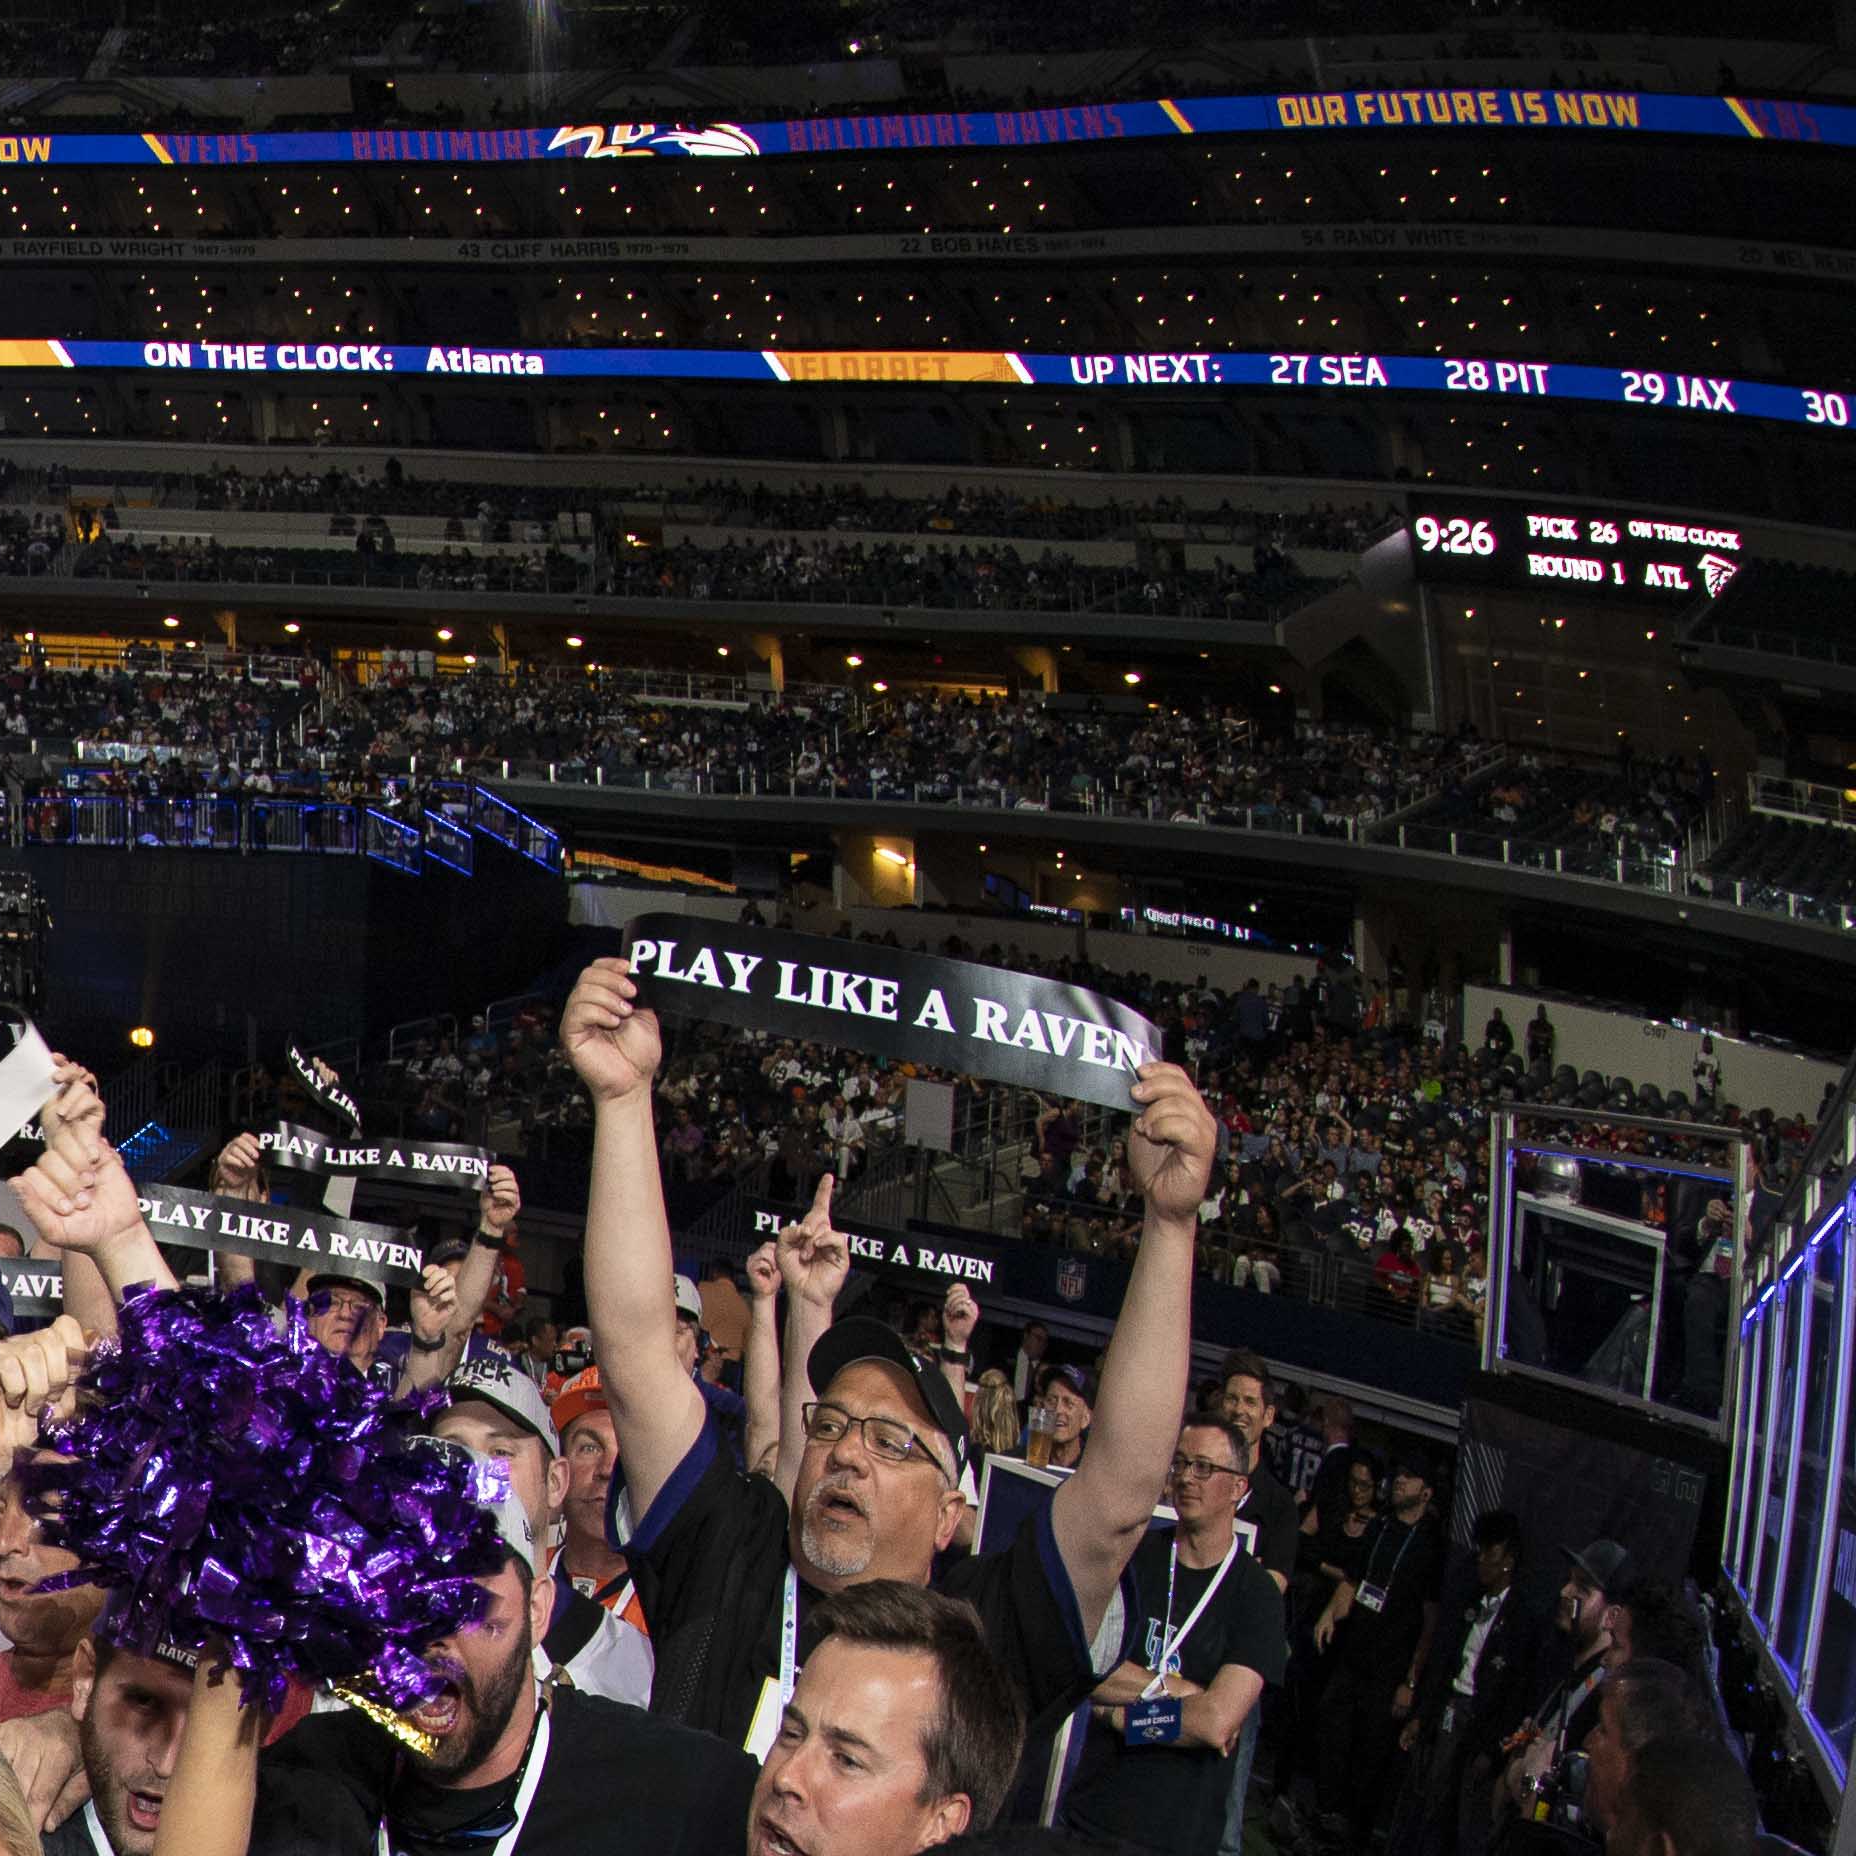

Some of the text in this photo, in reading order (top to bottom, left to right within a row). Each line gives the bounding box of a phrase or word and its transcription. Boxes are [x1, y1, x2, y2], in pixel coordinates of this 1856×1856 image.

[1278, 90, 1638, 128] OUR FUTURE IS NOW
[13, 241, 103, 257] RAYFIELD
[110, 241, 185, 257] WRIGHT
[458, 241, 620, 259] 43 CLIFF HARRIS
[931, 237, 971, 254] BOB
[976, 236, 1041, 254] HAYES
[1403, 228, 1469, 247] WHITE
[144, 342, 544, 376] ON THE CLOCK: Atlanta
[1070, 355, 1224, 384] UP NEXT:
[1270, 355, 1388, 388] 27 SEA
[1445, 360, 1551, 395] 28 PIT
[1621, 371, 1737, 414] 29 JAX
[1804, 390, 1848, 428] 30
[1415, 516, 1742, 557] 9:26 PICK 26 ON THE CLOCK
[1528, 554, 1690, 590] ROUND 1 ATL
[629, 940, 1147, 1073] PLAY LIKE A RAVEN
[291, 1045, 325, 1092] PLAY
[258, 1133, 488, 1178] PLAY LIKE A RAVEN
[137, 1196, 423, 1272] PLAY LIKE A RAVEN
[891, 1244, 993, 1283] A RAVEN
[156, 1641, 197, 1668] RAVE
